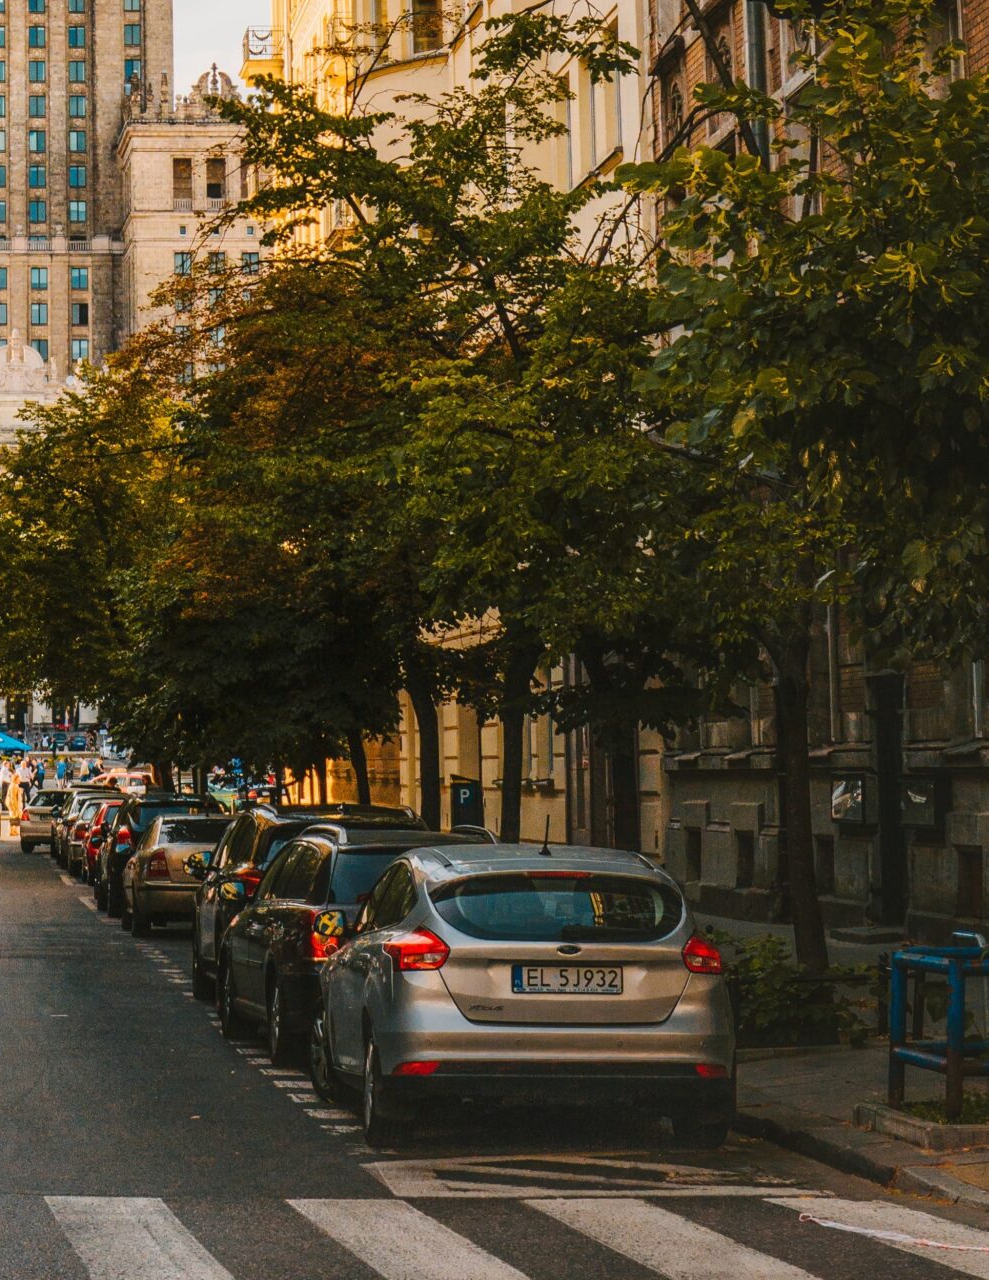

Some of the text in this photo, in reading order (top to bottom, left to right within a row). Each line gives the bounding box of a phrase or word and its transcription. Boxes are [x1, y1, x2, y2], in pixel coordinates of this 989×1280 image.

[460, 788, 470, 804] P
[527, 968, 618, 988] EL 5J932
